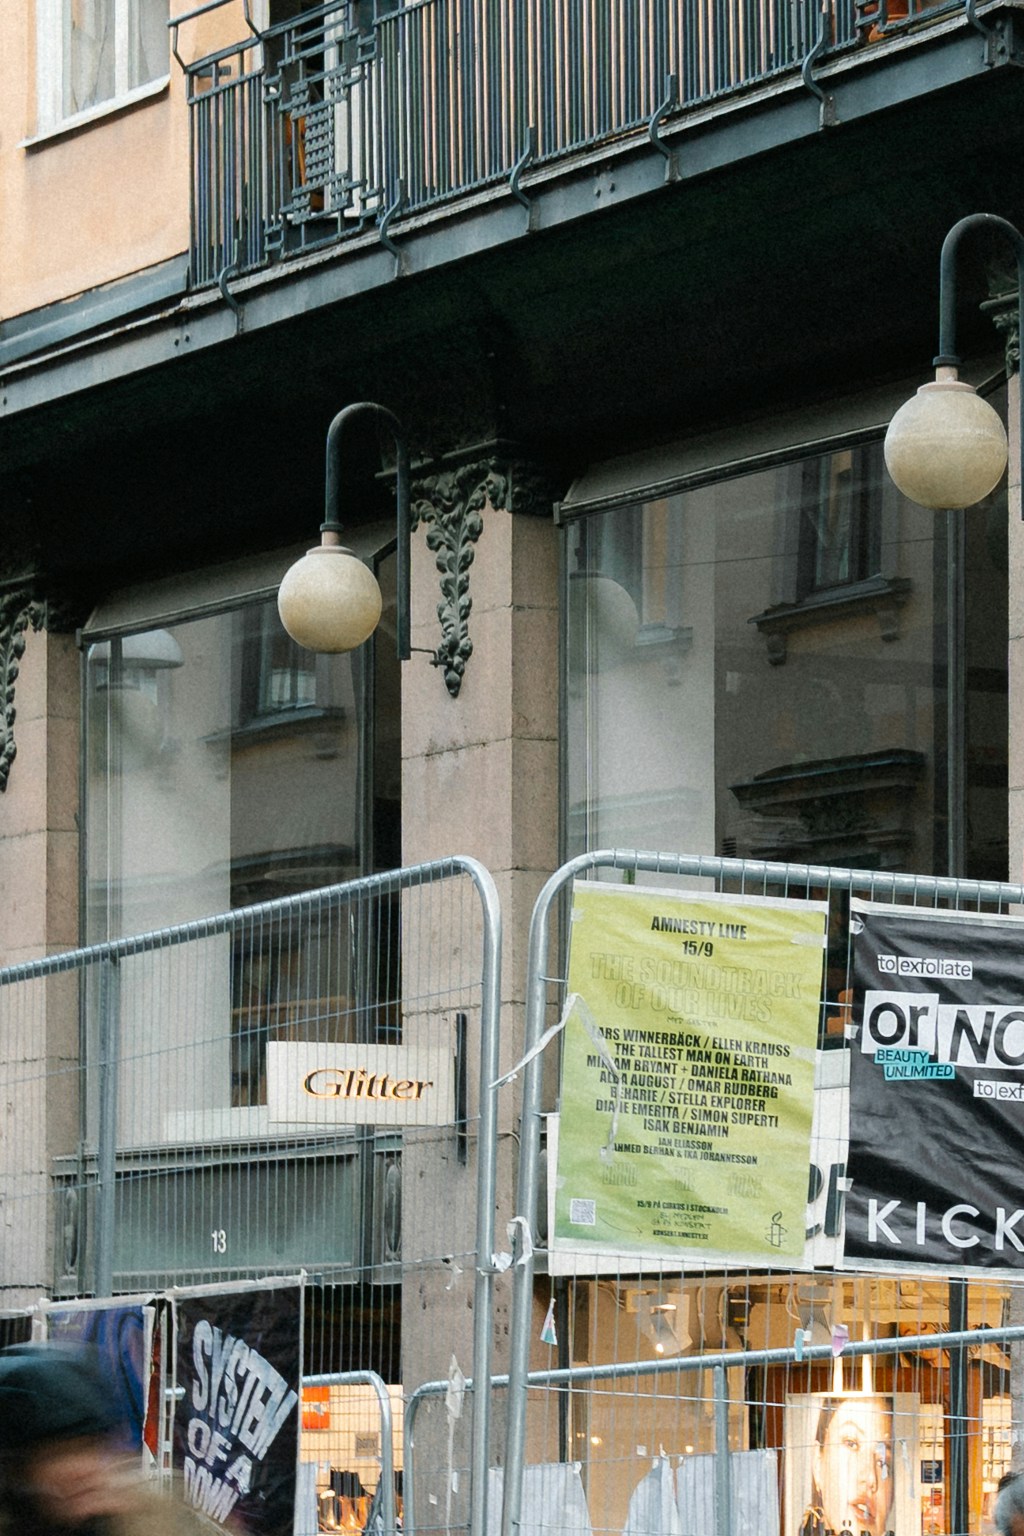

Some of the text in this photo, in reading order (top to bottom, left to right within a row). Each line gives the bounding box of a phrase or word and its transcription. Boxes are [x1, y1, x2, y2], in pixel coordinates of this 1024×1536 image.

[651, 916, 747, 940] AMNESTY LIVE
[682, 940, 714, 957] 15/9
[590, 952, 802, 999] THE SOUNDTRACK
[877, 956, 971, 977] to exfoliate
[615, 981, 774, 1022] OF OUR LIVES
[868, 1002, 929, 1046] or
[615, 1043, 769, 1068] THE TALLEST MAN ON EARTH
[623, 1029, 791, 1057] WINNERBÄCK ELLEN KRAUSS
[877, 1050, 928, 1063] BEAUTY
[304, 1066, 433, 1100] Glitter
[634, 1057, 792, 1086] BRYANT DANIELA RATHANA
[886, 1065, 953, 1078] UNLIMITED
[631, 1073, 778, 1098] AUGUST OMAR RUDBERG
[977, 1082, 993, 1096] to
[668, 1091, 708, 1108] STELLA
[711, 1095, 766, 1112] EXPLORER
[632, 1102, 779, 1128] EMERITA SIMON SUPERTI
[643, 1118, 729, 1138] ISAK BENJAMIN
[658, 1138, 713, 1151] JAN ELIASSON
[211, 1229, 227, 1254] 13
[192, 1319, 299, 1461] SYSTEM
[187, 1417, 253, 1494] OF A
[184, 1455, 239, 1524] DOWN
